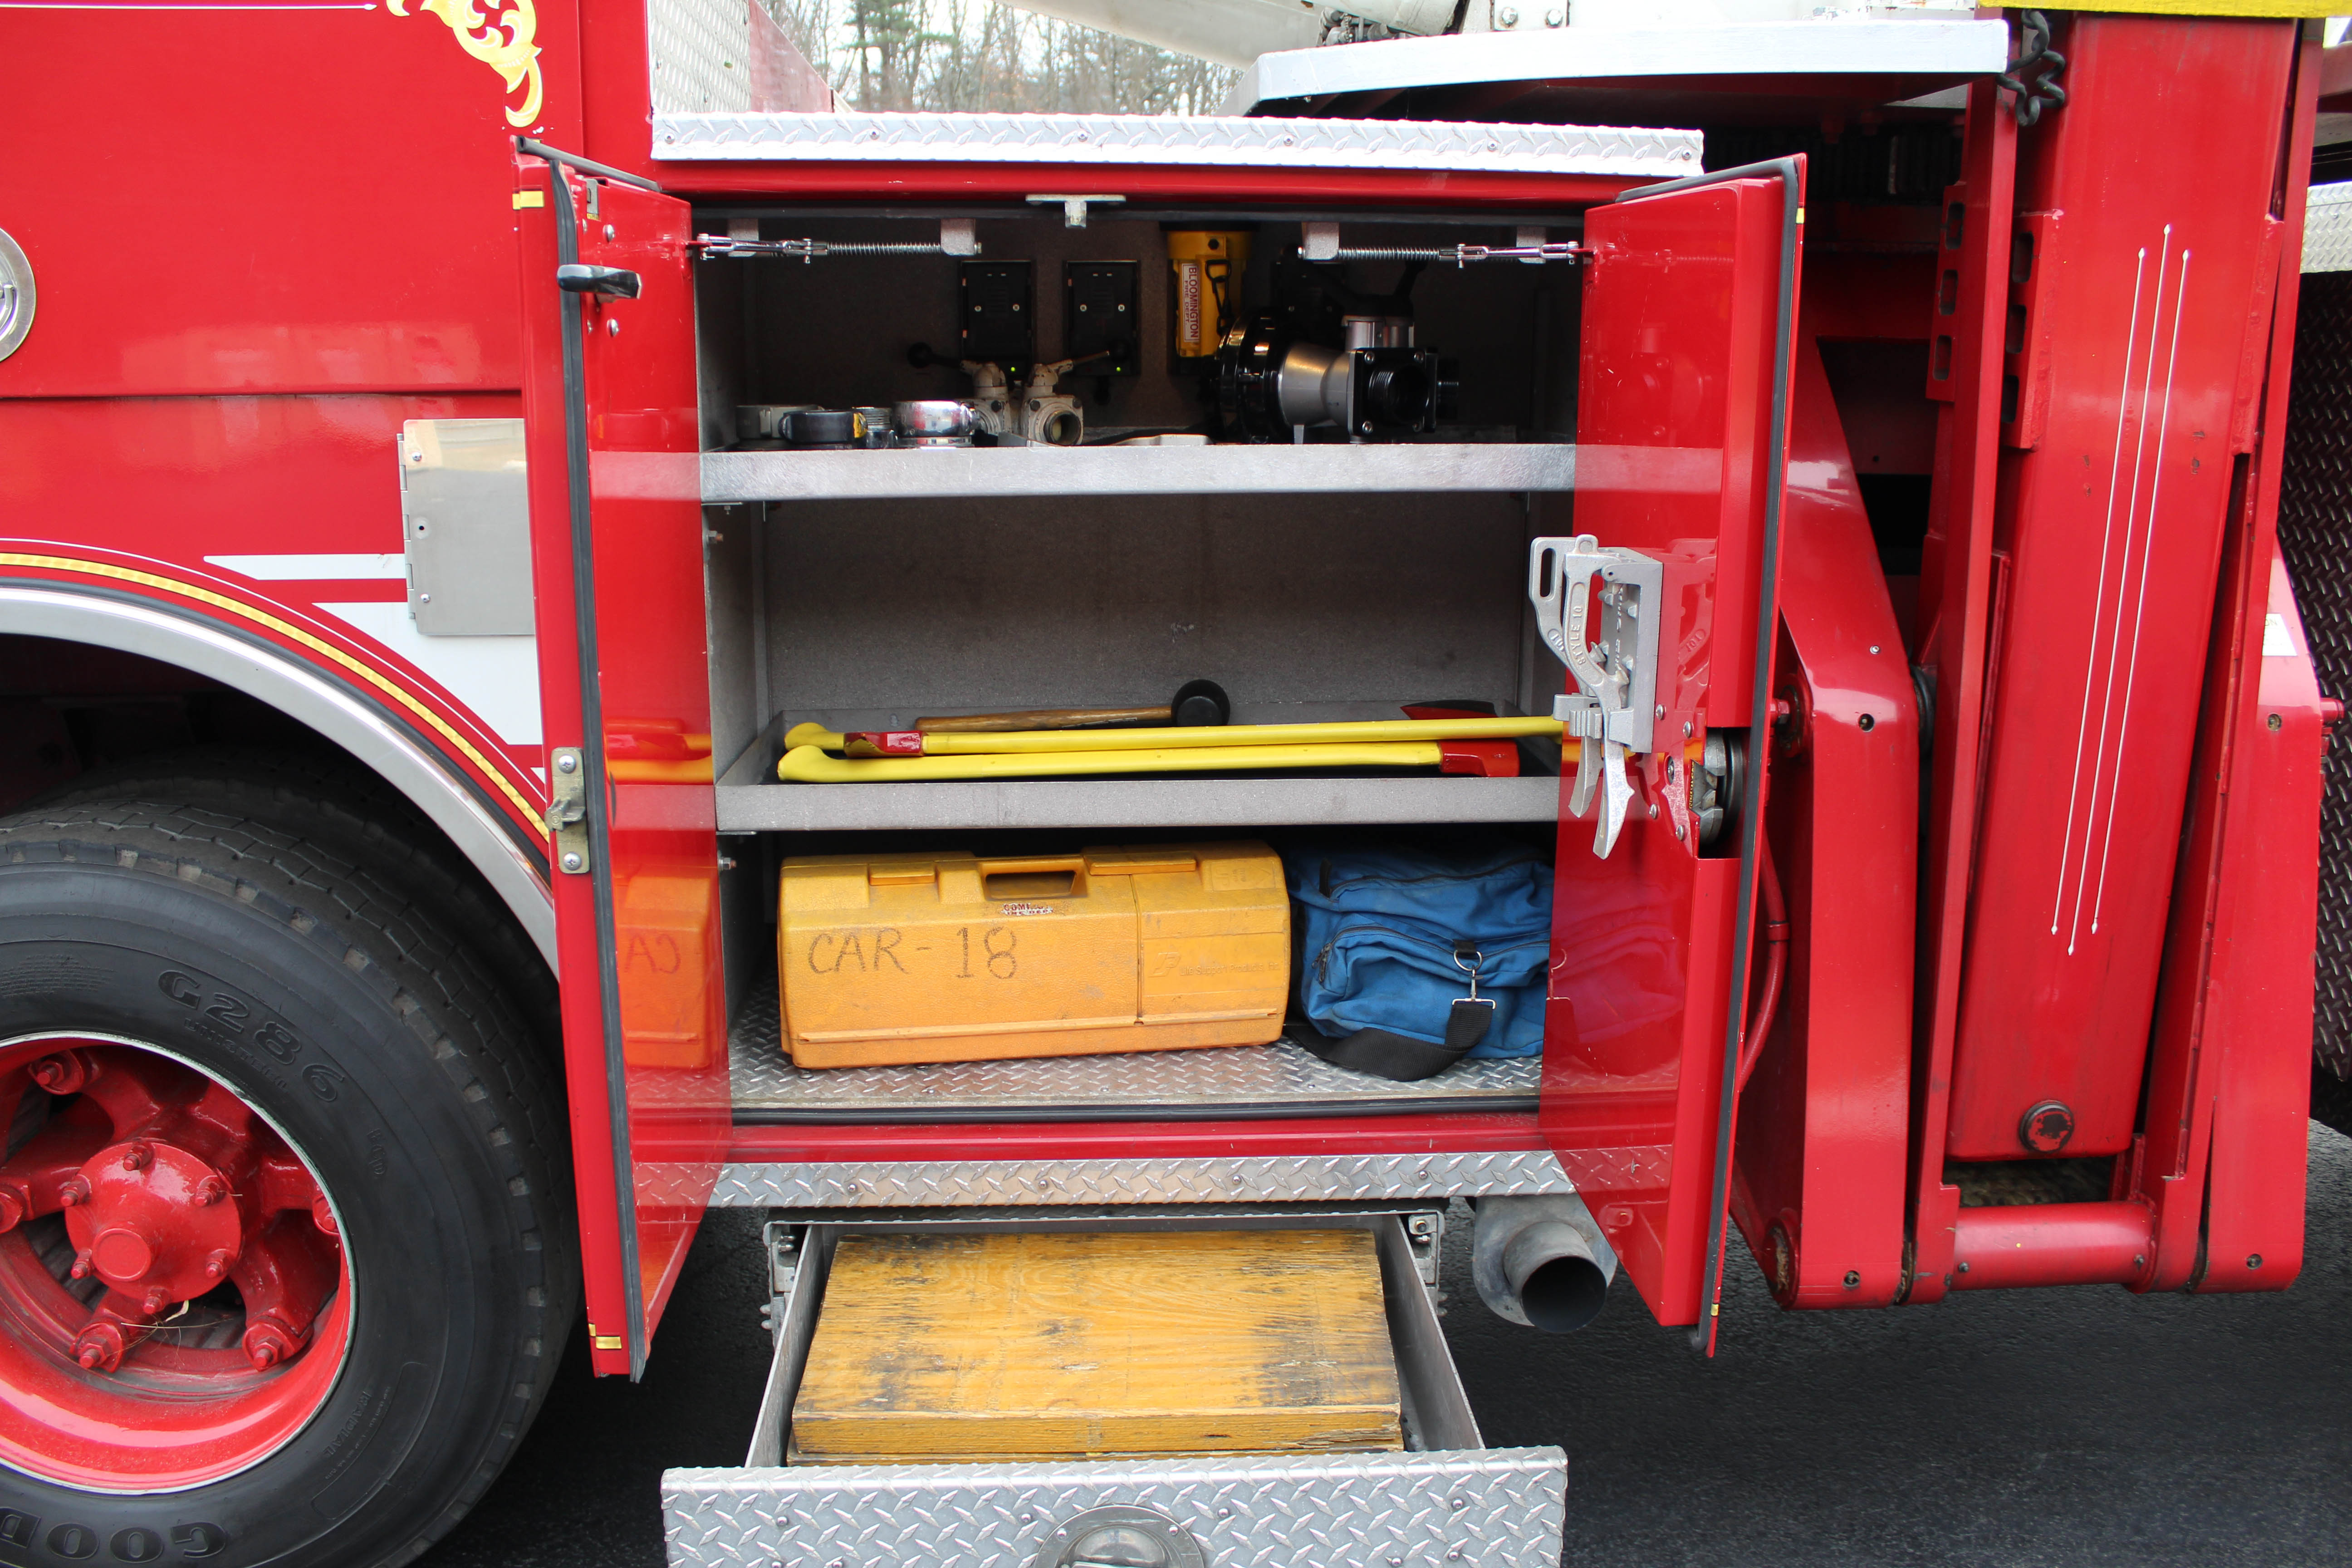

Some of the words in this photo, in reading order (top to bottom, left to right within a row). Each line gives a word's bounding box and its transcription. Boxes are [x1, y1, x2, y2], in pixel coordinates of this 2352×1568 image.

[1189, 267, 1199, 338] BLOOMINGTON
[1570, 625, 1586, 665] STYLE
[808, 928, 908, 974] CAR
[956, 926, 1017, 980] 18
[1180, 965, 1194, 976] Life
[1196, 965, 1228, 976] Support
[158, 970, 345, 1102] G286
[0, 1506, 226, 1564] GOOD
